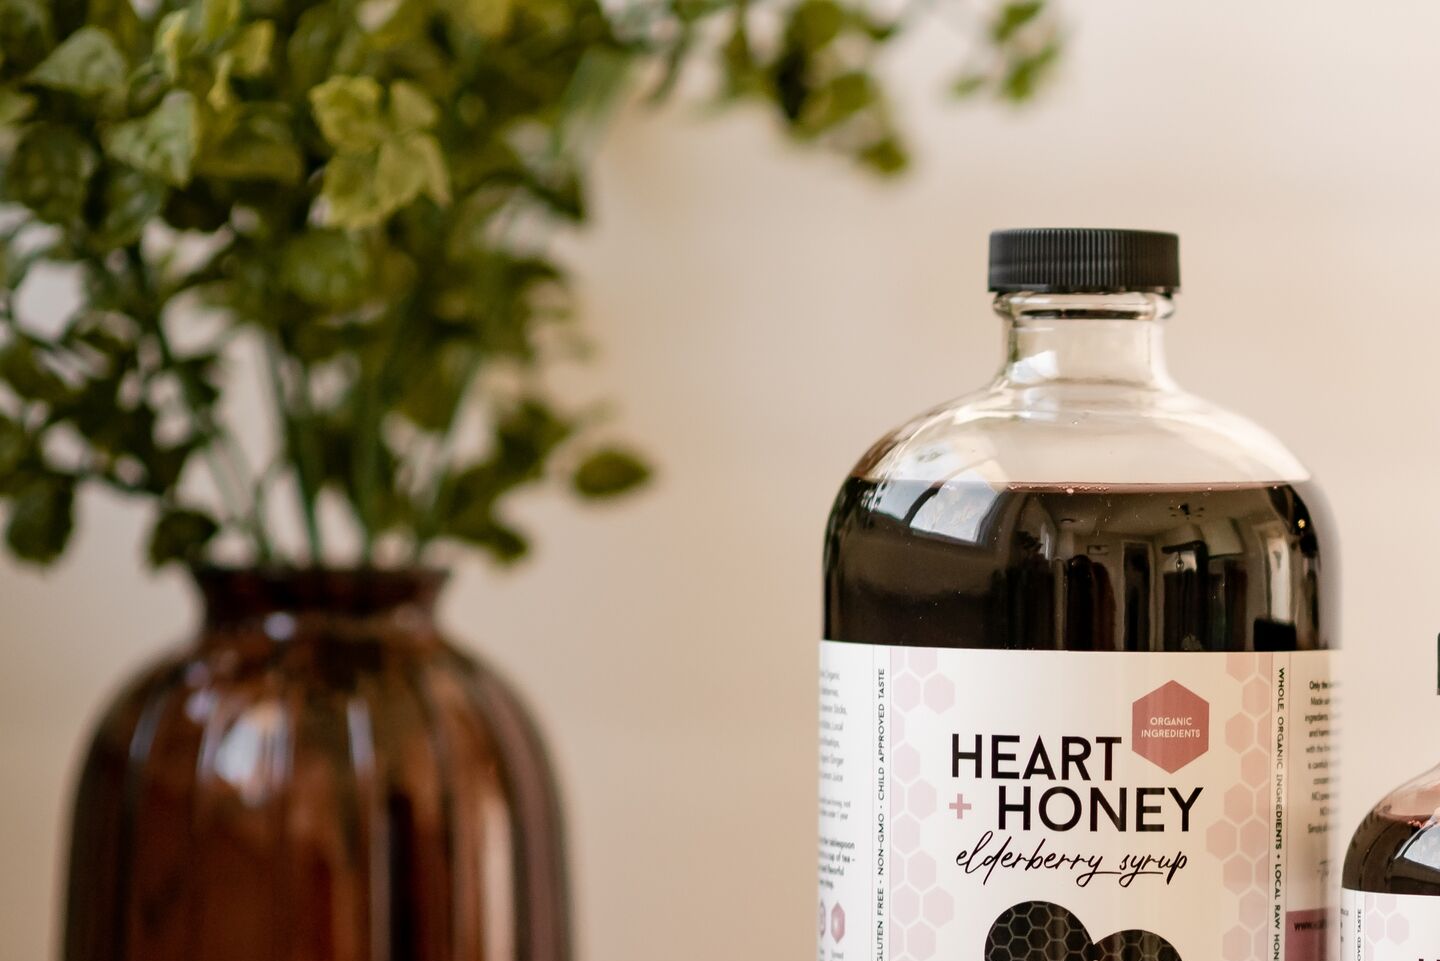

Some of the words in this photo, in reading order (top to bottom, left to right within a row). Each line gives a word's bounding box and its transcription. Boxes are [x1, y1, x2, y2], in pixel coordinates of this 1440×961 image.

[877, 668, 885, 699] TASTE
[1277, 668, 1285, 711] WHOLE
[877, 704, 885, 762] APPROVED
[1141, 729, 1201, 738] INGREDIENTS
[1150, 716, 1193, 726] ORGANIC
[1276, 717, 1284, 769] ORGANIC
[951, 733, 1122, 781] HEART
[877, 767, 885, 800] CHILD
[998, 785, 1204, 833] HONEY
[1275, 774, 1283, 849] INGREDIENTS
[877, 813, 885, 875] NON-GMO
[956, 831, 1121, 888] elderberry
[1118, 851, 1188, 888] syrup
[876, 888, 884, 916] FREE
[1274, 864, 1282, 900] LOCAL
